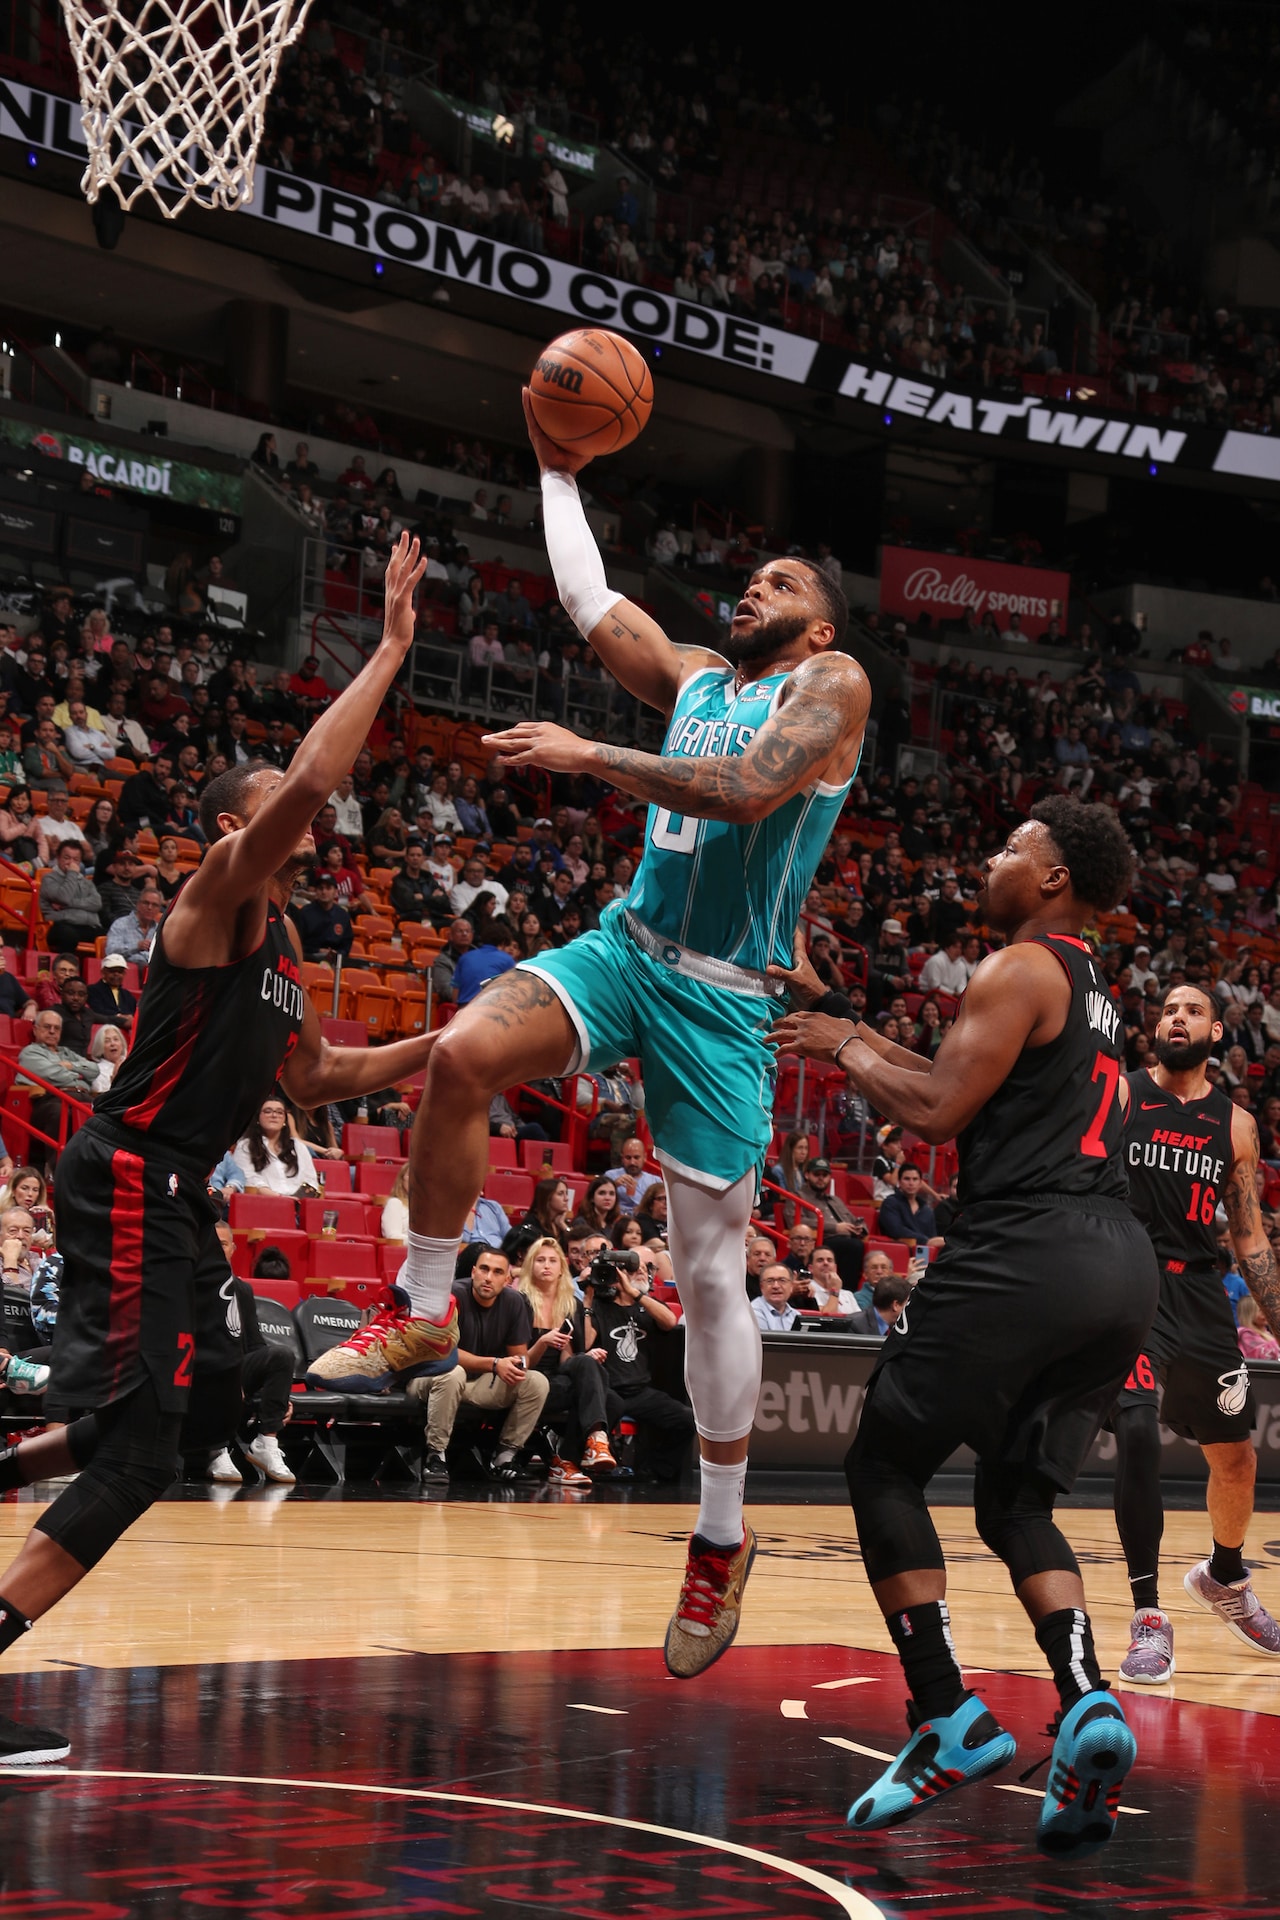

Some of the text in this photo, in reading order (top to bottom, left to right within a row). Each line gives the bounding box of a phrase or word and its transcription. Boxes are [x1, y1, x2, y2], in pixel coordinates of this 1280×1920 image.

[262, 170, 552, 300] PROMO
[569, 273, 775, 371] CODE:
[219, 517, 235, 533] 120
[903, 567, 1048, 618] Bally SPORTS
[667, 715, 757, 757] ORNETS
[261, 967, 304, 1024] CULTU
[1084, 990, 1120, 1046] LOWRY
[1081, 1051, 1119, 1158] 7
[1128, 1141, 1225, 1185] CULTURE
[1151, 1128, 1213, 1151] HEAT
[1186, 1181, 1217, 1227] 16
[258, 1322, 292, 1336] RANT
[754, 1370, 866, 1434] etw
